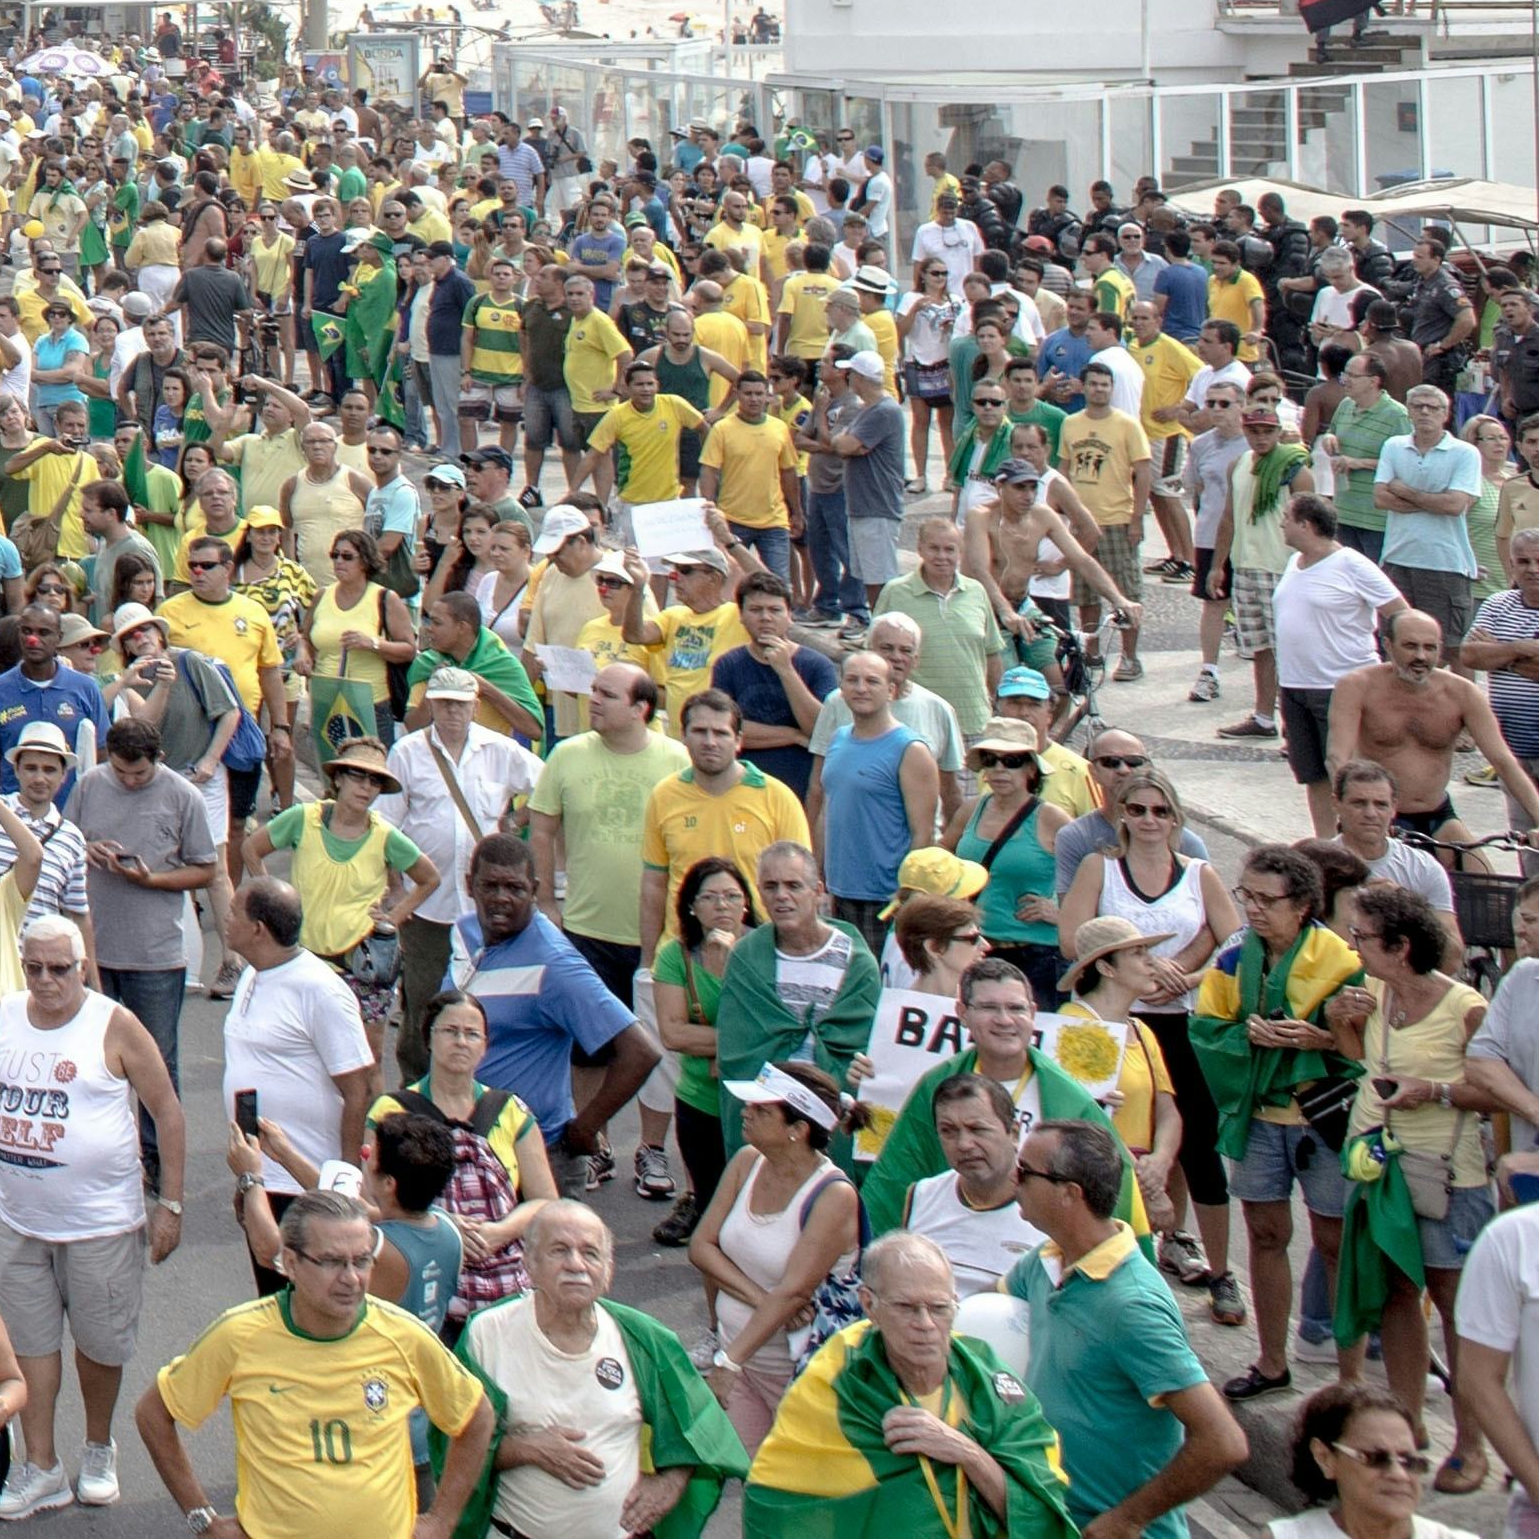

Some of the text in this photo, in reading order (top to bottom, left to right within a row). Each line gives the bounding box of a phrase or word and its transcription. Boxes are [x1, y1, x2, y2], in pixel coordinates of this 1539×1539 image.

[683, 815, 697, 829] 10
[57, 1064, 73, 1079] BE
[309, 1417, 352, 1466] 10
